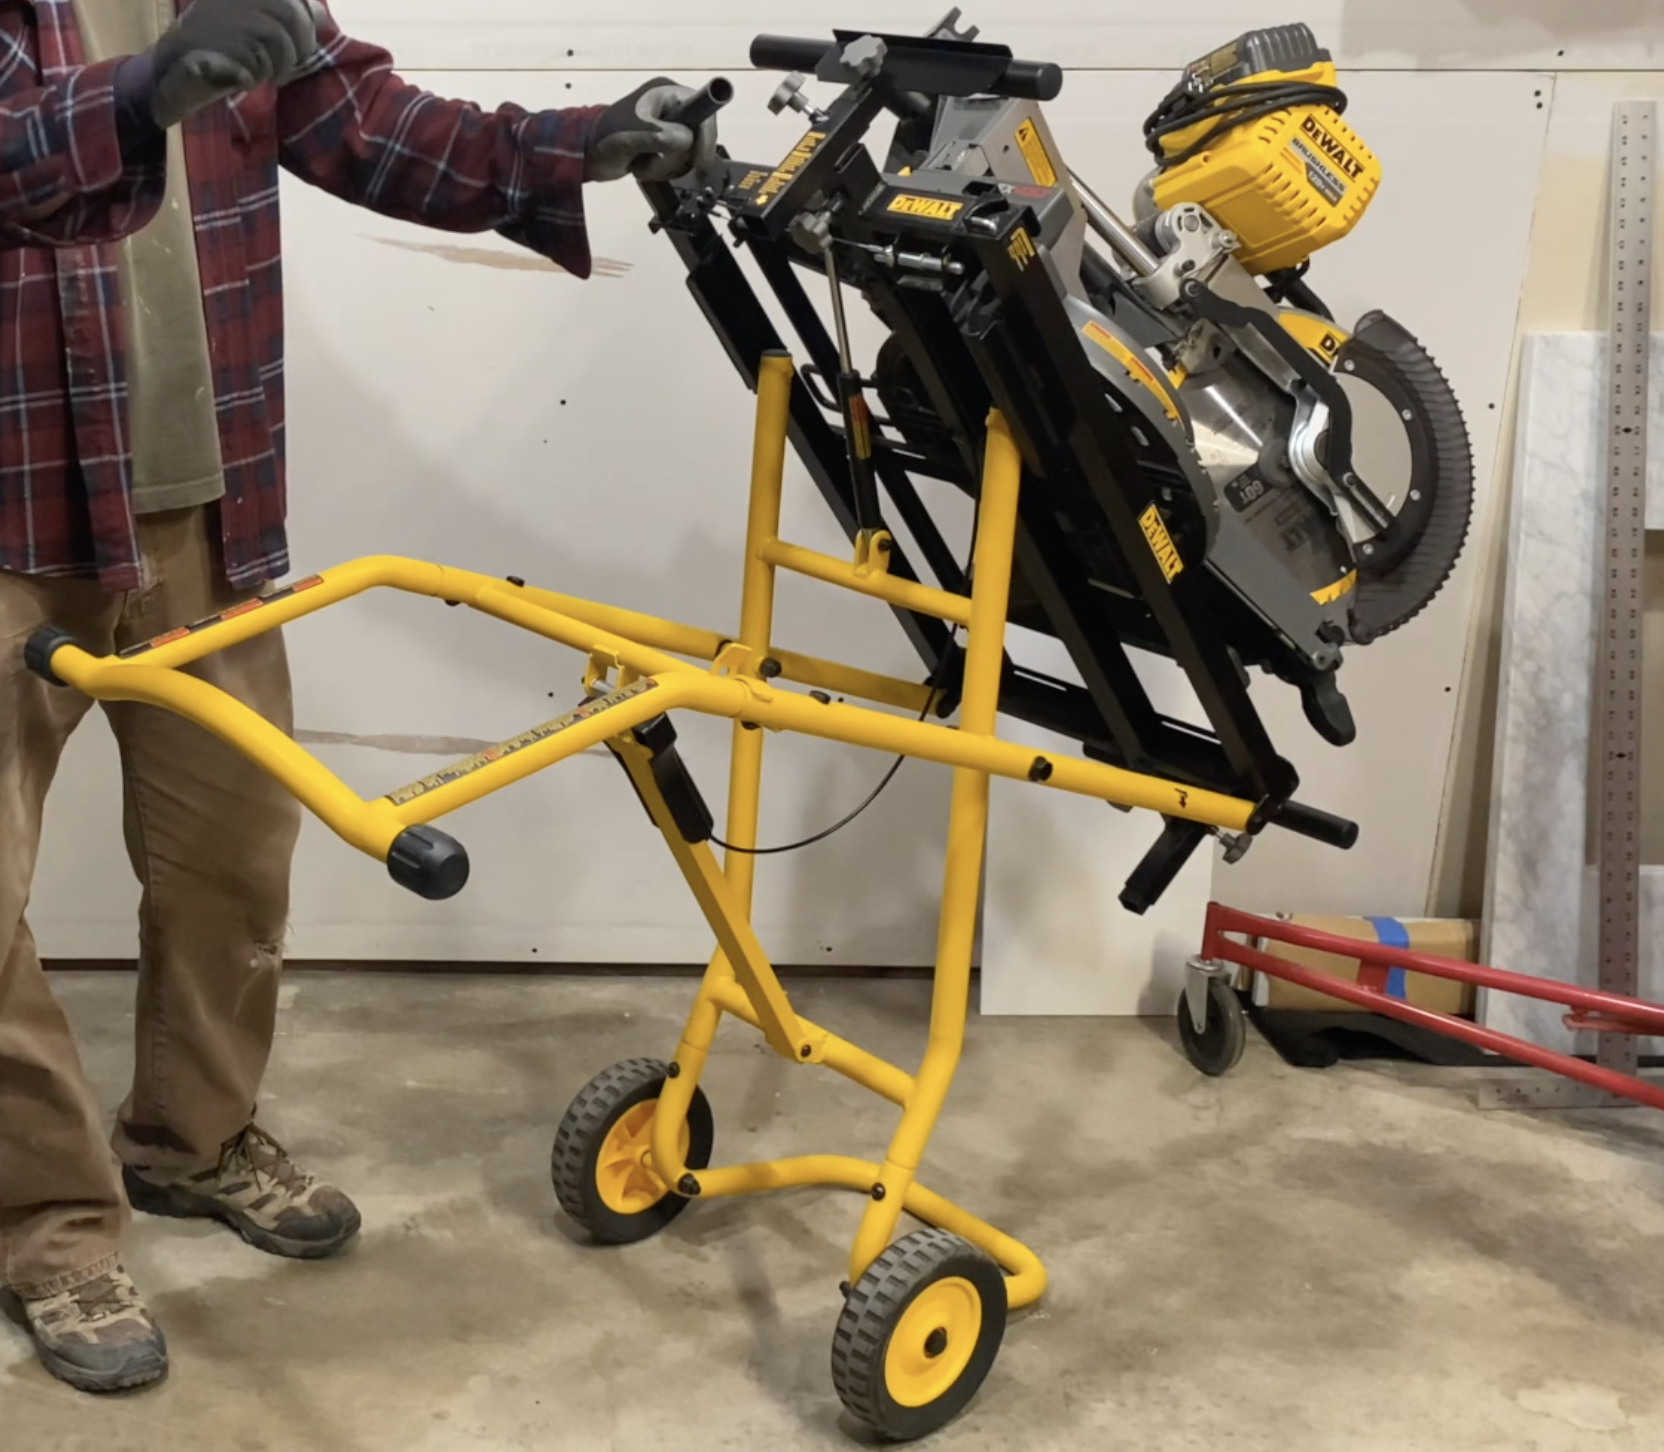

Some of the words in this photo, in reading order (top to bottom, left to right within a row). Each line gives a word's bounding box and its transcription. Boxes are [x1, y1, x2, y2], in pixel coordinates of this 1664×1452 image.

[1292, 137, 1346, 192] BRUSHLESS
[1301, 116, 1364, 179] DEWALT
[887, 194, 963, 219] DEWALT
[1139, 505, 1184, 583] DEWALT
